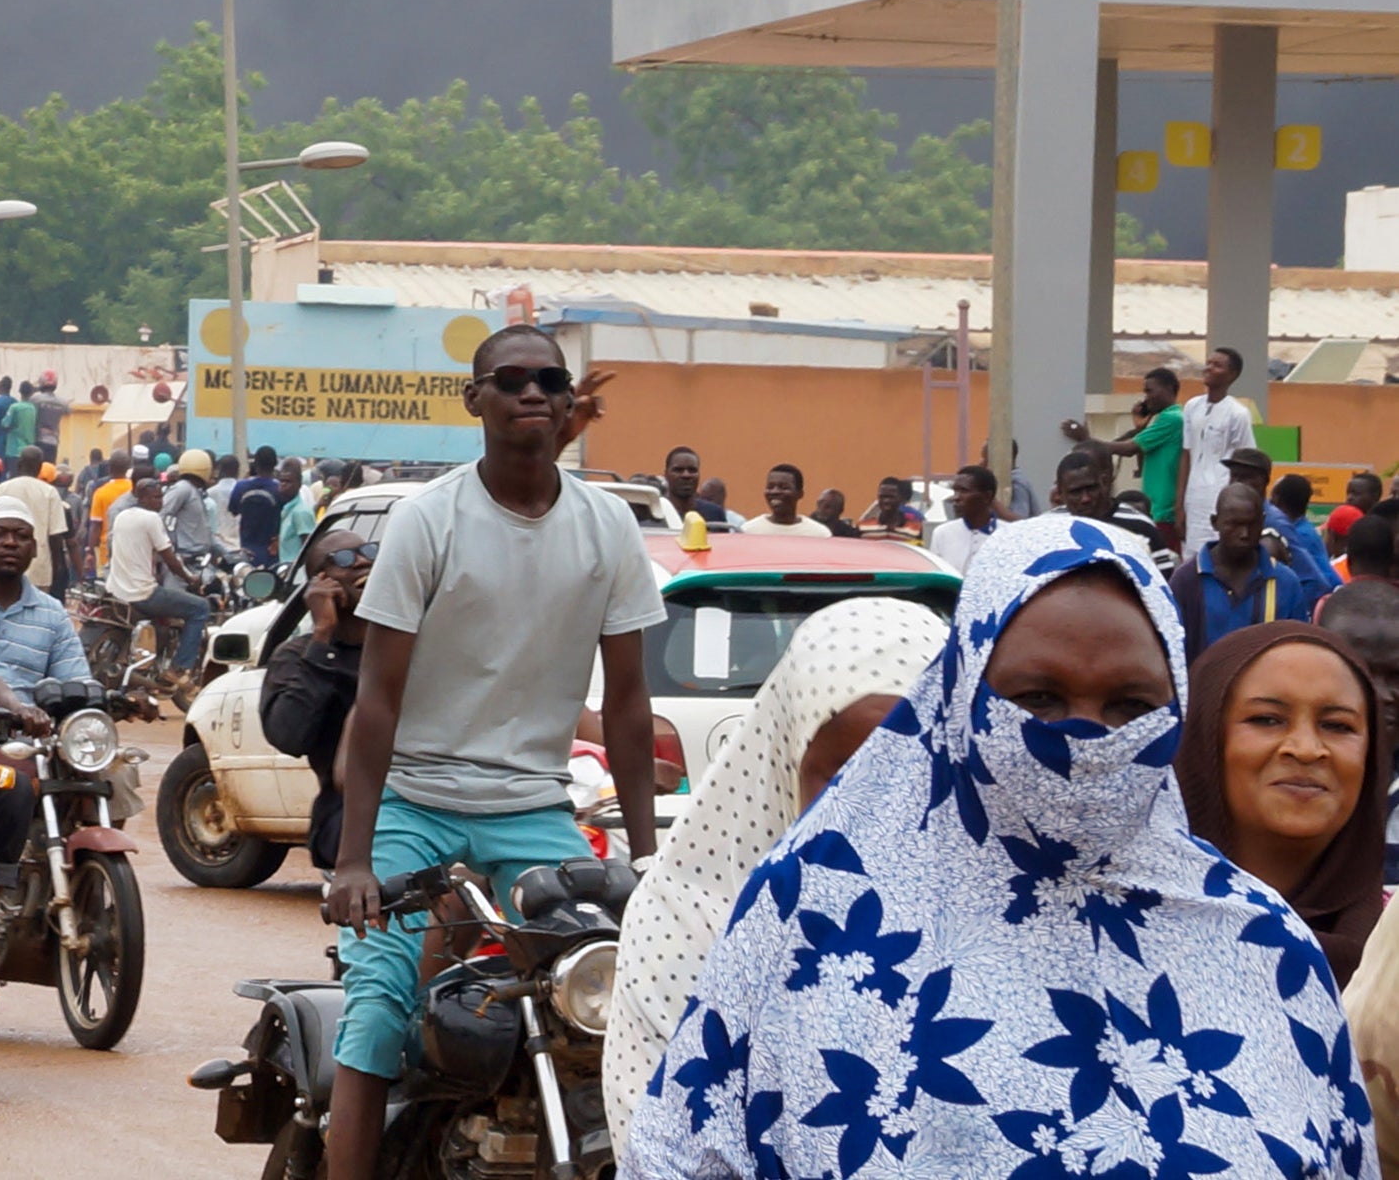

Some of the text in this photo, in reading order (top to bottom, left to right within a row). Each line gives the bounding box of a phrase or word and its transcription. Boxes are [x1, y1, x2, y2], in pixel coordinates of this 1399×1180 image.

[1181, 130, 1196, 159] 1
[1287, 132, 1308, 162] 2
[260, 394, 431, 422] SIEGE NATIONAL
